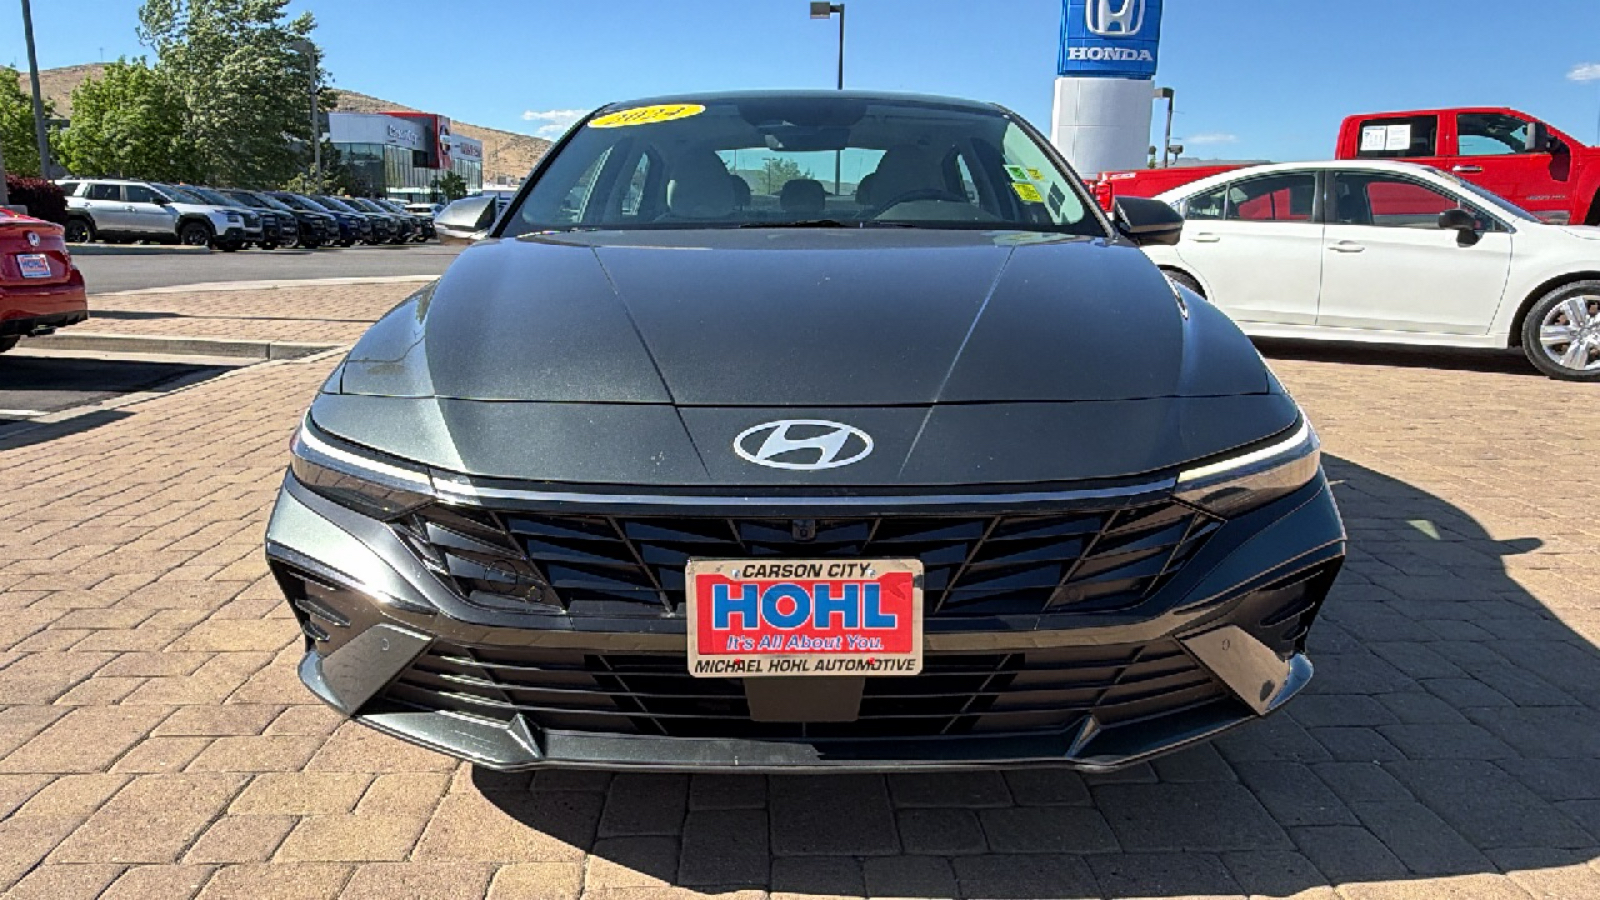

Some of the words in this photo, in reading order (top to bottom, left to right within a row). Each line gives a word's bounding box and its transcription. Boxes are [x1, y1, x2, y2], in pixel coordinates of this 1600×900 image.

[1068, 47, 1154, 61] HONDA
[742, 564, 823, 578] CARSON
[827, 562, 871, 578] CITY
[711, 583, 898, 630] HOHL
[726, 635, 755, 651] It's
[757, 634, 784, 651] All
[785, 634, 842, 650] About
[846, 634, 884, 650] You.
[694, 659, 763, 673] MICHAEL
[767, 658, 811, 673] HOHL
[814, 658, 916, 672] AUTOMOTIVE
